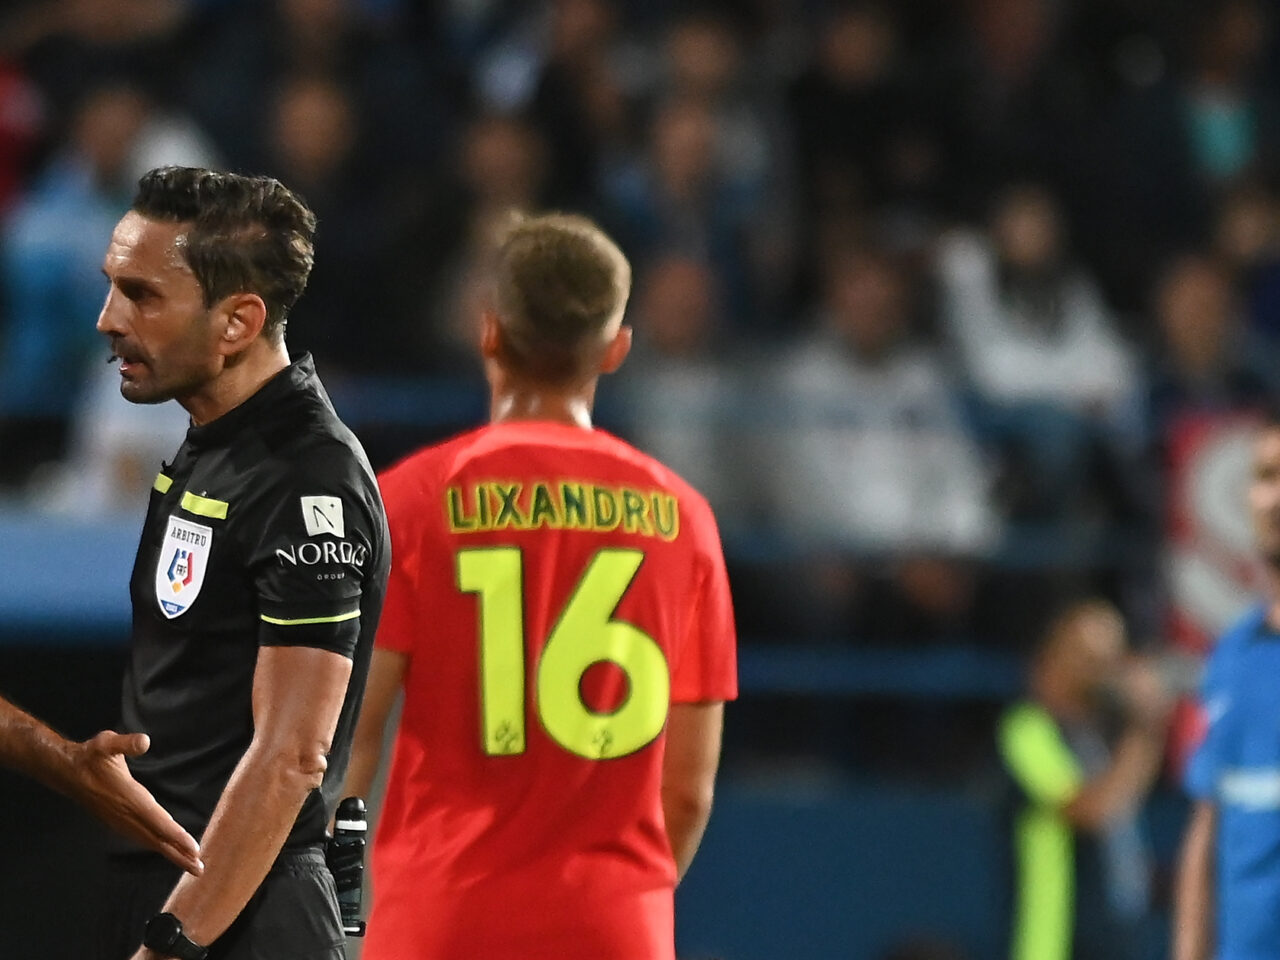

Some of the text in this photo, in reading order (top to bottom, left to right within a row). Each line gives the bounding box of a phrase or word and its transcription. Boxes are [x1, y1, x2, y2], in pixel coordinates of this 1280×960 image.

[170, 527, 207, 547] ARBITRU
[447, 482, 680, 542] LIXANDRU
[456, 547, 670, 761] 16
